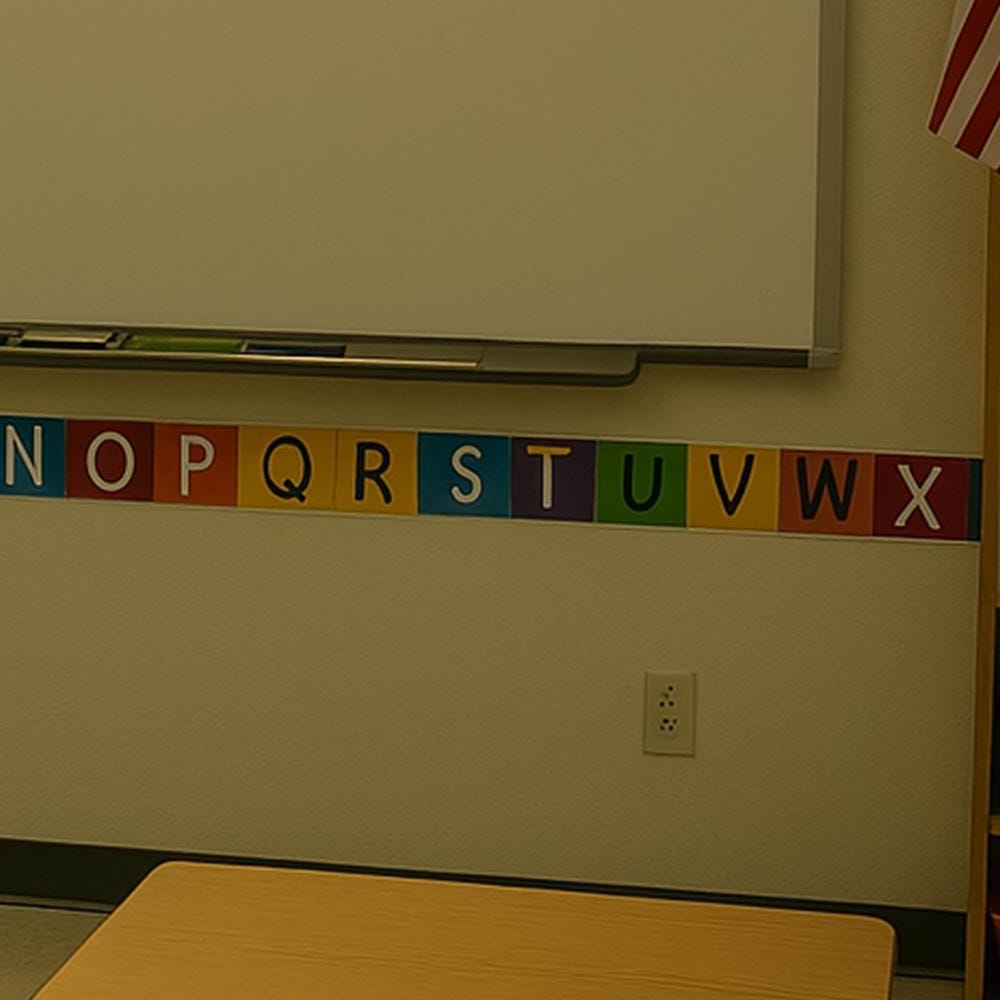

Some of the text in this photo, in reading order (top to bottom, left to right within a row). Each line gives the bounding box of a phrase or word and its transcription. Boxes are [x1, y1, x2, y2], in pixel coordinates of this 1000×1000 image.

[5, 425, 43, 486] N
[86, 431, 135, 492] O
[180, 435, 215, 496] P
[263, 436, 311, 503] Q
[355, 442, 391, 504] R
[451, 445, 482, 504] S
[526, 445, 571, 509] T
[623, 454, 663, 511] U
[710, 454, 755, 516] V
[796, 456, 857, 521] W
[894, 464, 942, 530] X
